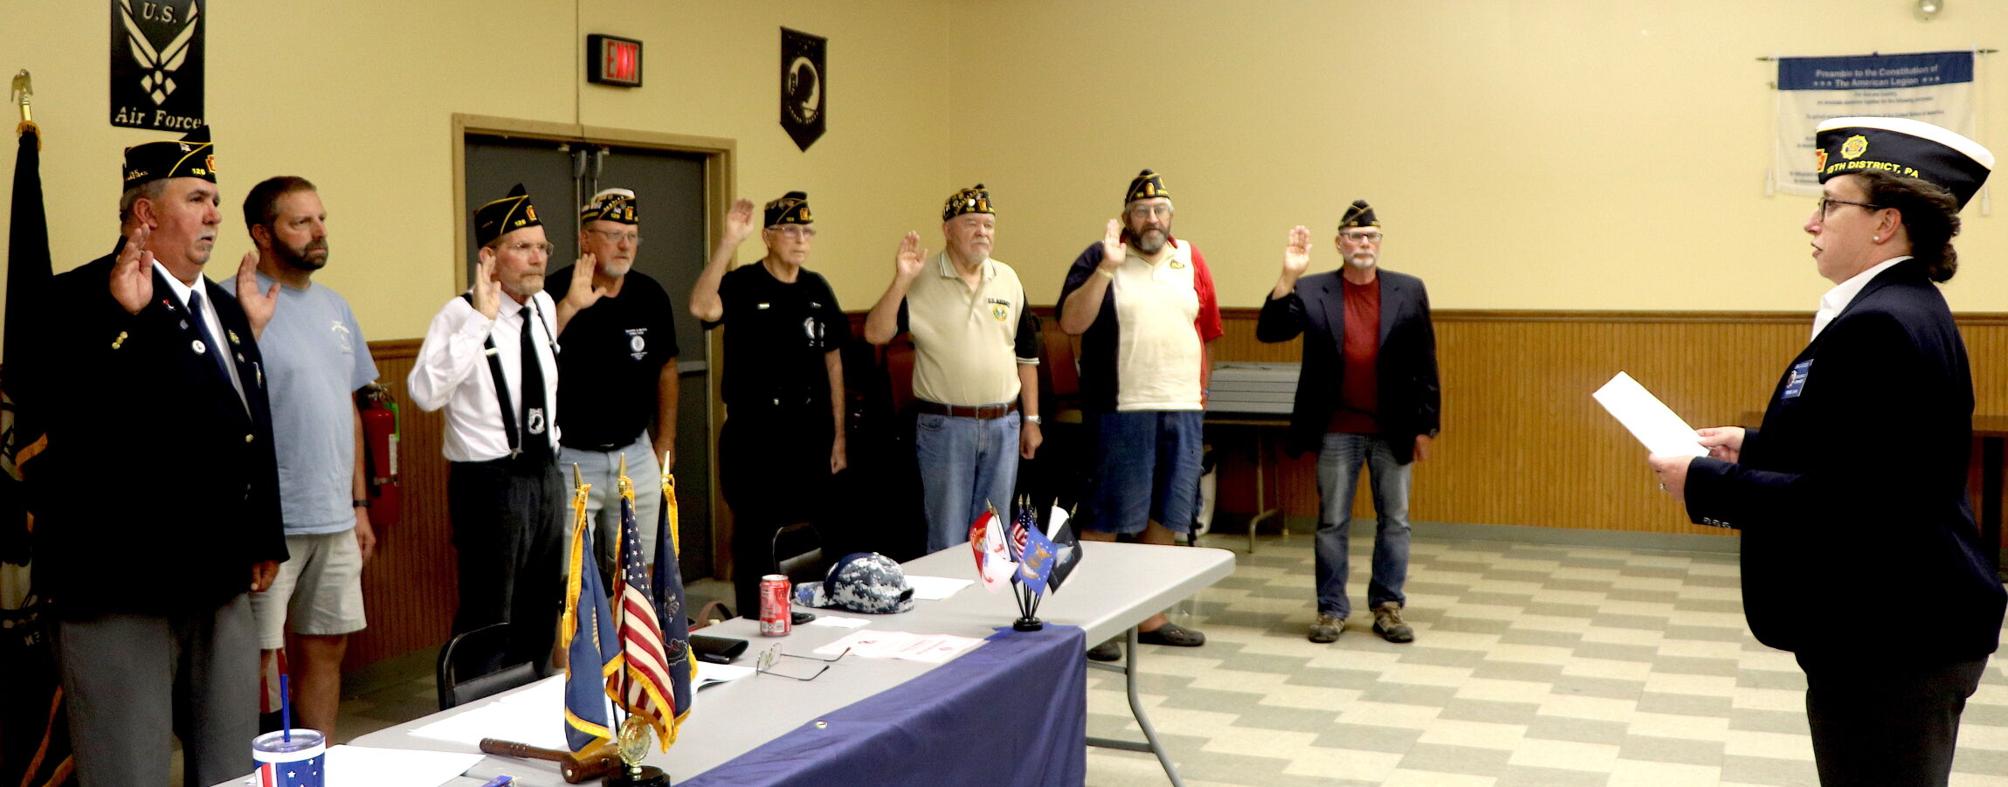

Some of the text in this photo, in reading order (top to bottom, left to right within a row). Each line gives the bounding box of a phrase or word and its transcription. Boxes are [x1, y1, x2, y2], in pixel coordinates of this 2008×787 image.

[143, 3, 177, 23] U.S.
[1865, 68, 1878, 77] the
[115, 106, 202, 129] Air Force
[1904, 167, 1919, 178] PA
